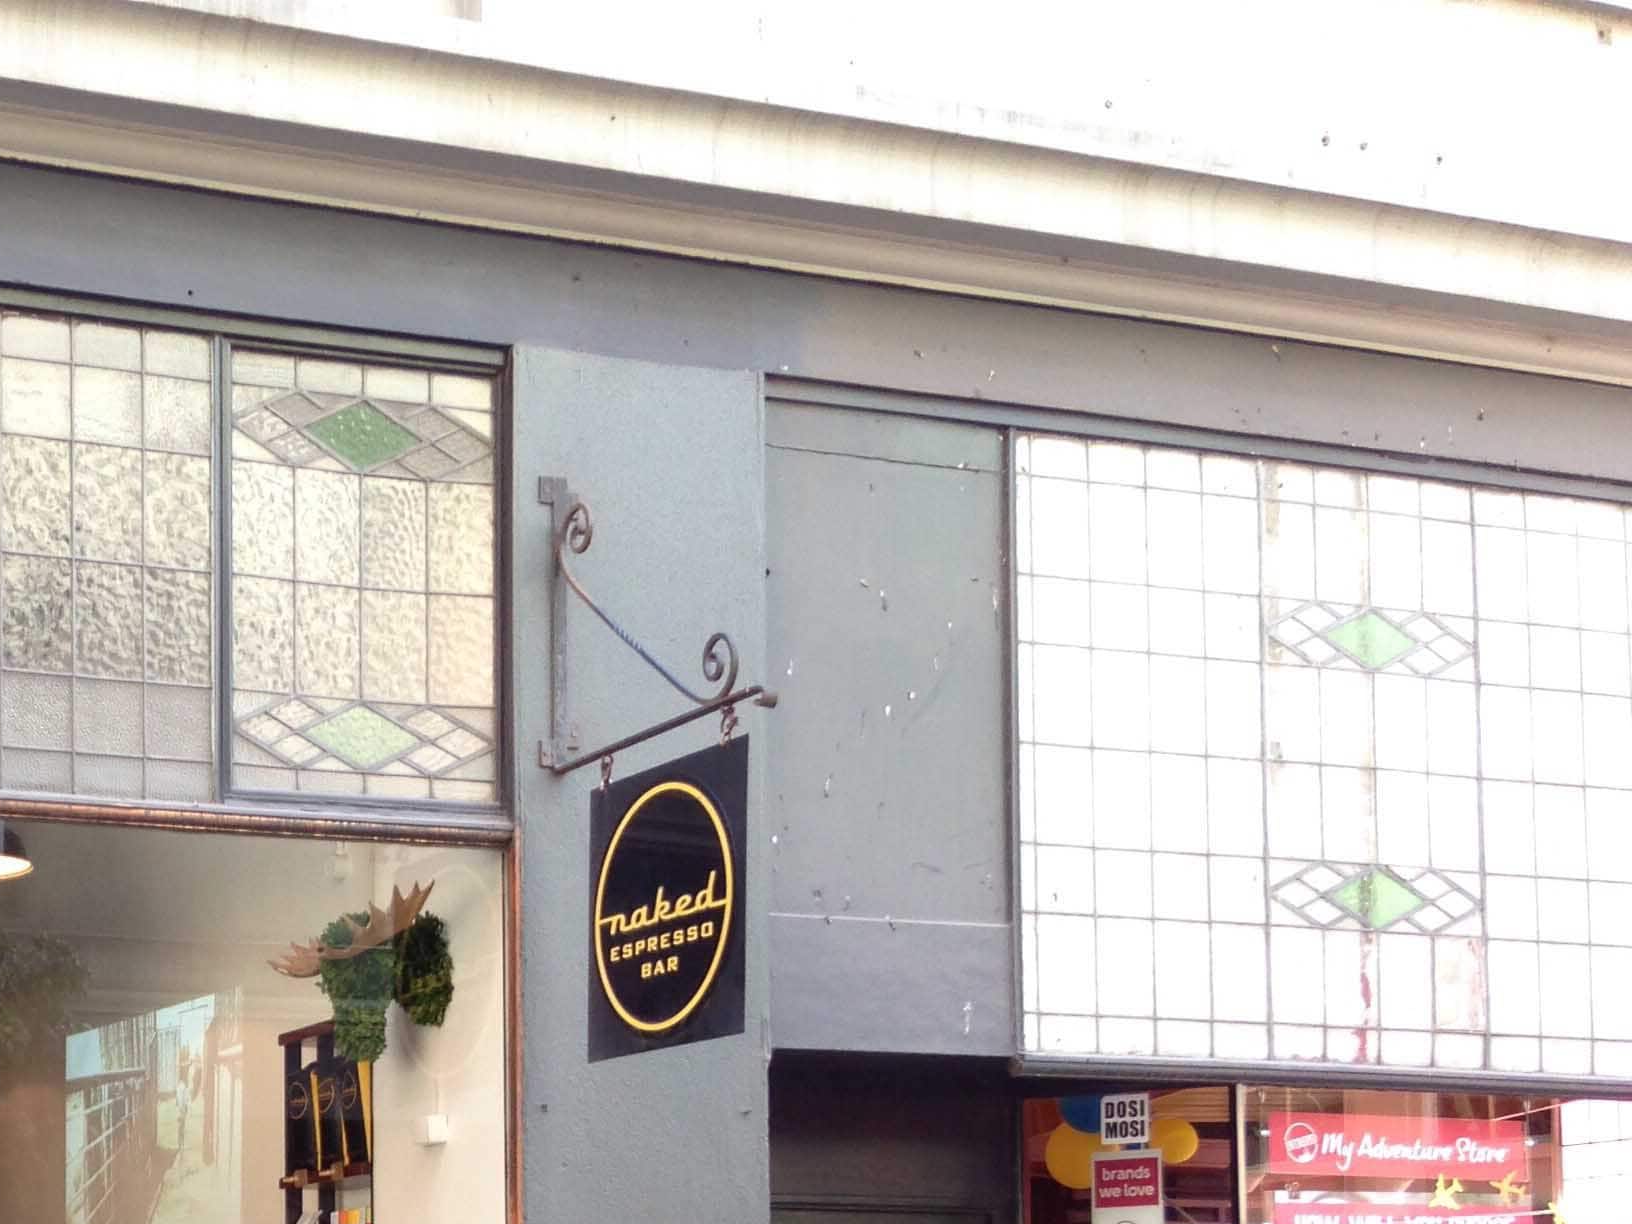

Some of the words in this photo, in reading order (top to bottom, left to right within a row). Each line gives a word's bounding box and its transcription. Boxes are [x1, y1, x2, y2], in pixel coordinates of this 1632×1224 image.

[602, 869, 724, 936] naked
[610, 921, 715, 961] ESPRESSO
[641, 956, 679, 978] BAR
[1104, 1099, 1145, 1119] DOSI
[1104, 1120, 1145, 1139] MOSI
[1321, 1133, 1355, 1171] My
[1357, 1133, 1453, 1162] Adventure
[1456, 1137, 1510, 1163] Store
[1102, 1166, 1151, 1181] brands
[1099, 1186, 1121, 1198] we
[1124, 1183, 1154, 1197] love
